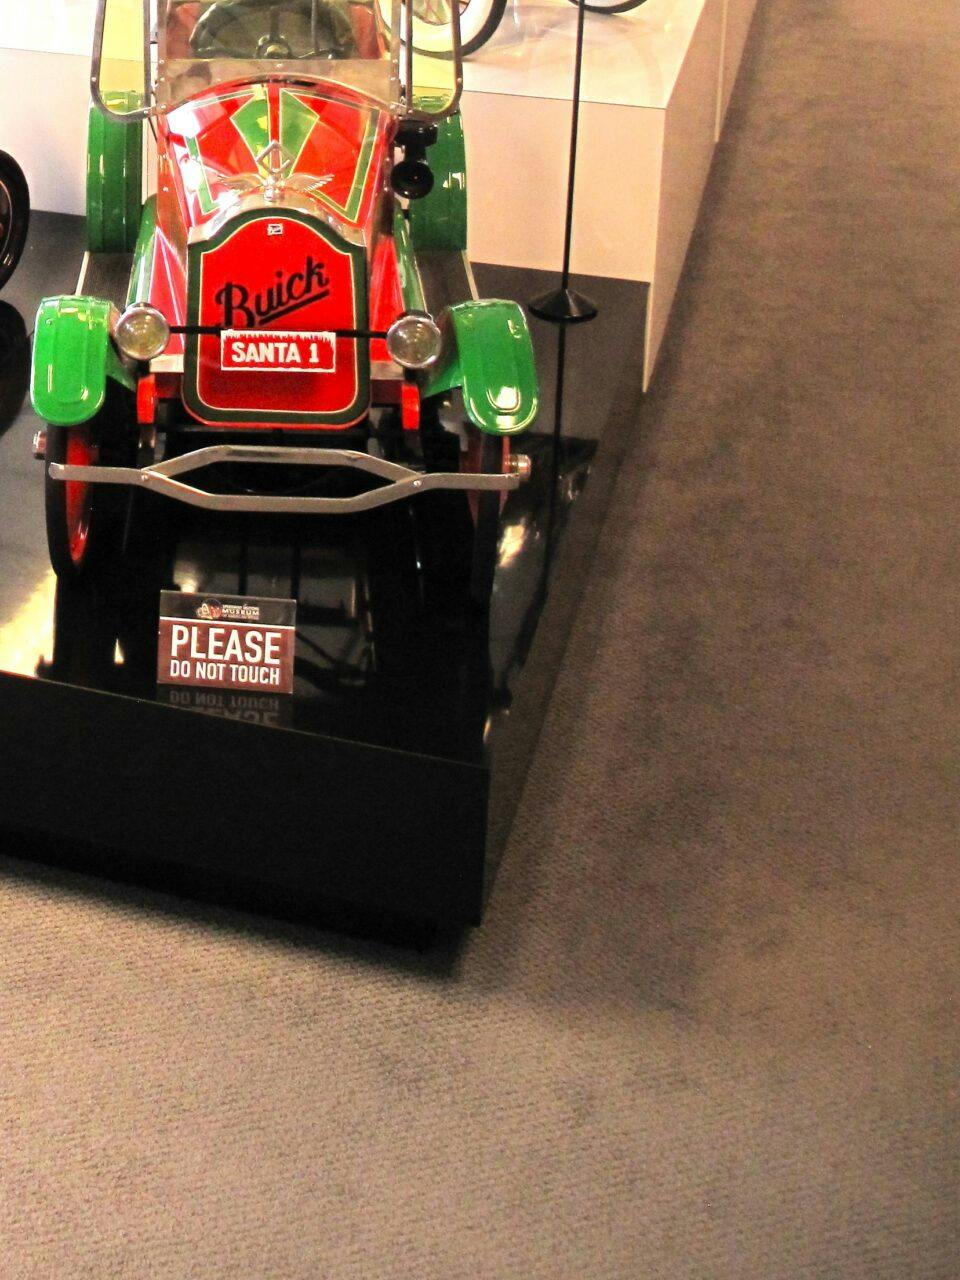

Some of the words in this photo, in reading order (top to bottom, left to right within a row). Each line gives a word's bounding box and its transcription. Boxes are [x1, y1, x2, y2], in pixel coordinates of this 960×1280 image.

[214, 256, 330, 328] Buick
[231, 341, 300, 363] SANTA
[309, 342, 321, 363] 1
[222, 608, 260, 616] MUSEUM
[170, 624, 282, 665] PLEASE
[170, 660, 191, 678] DO
[195, 661, 227, 681] NOT
[230, 664, 281, 685] TOUCH
